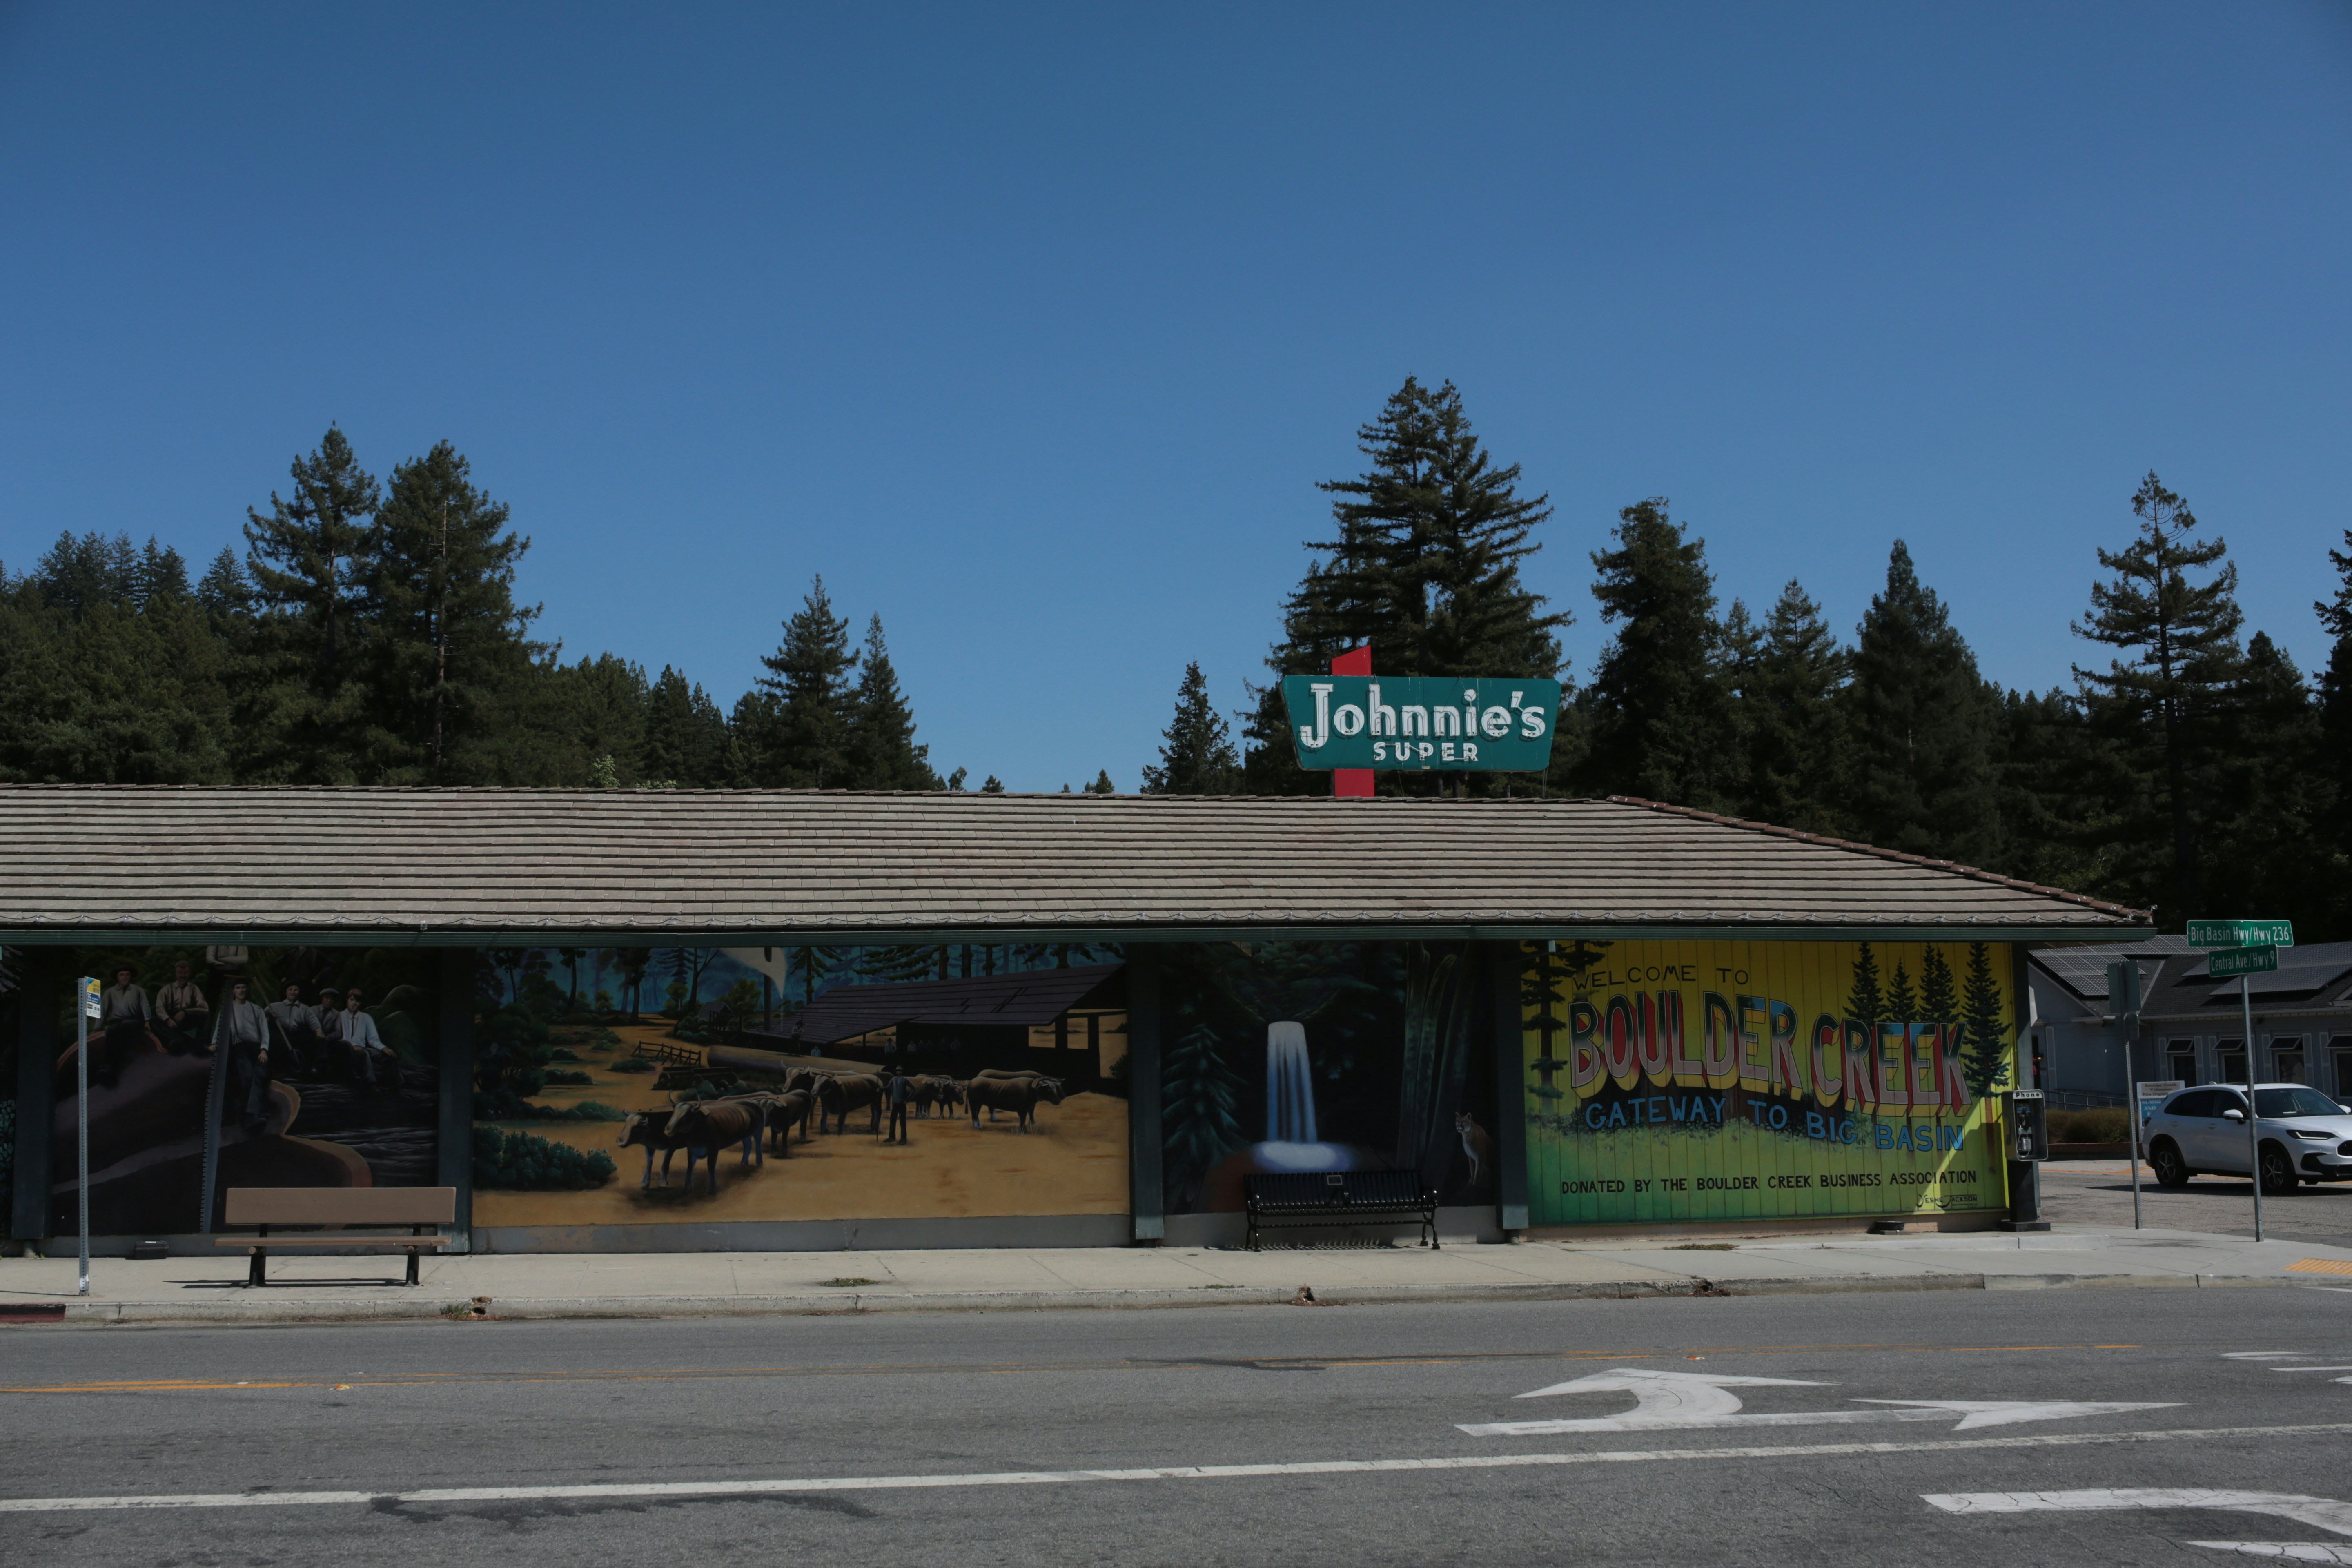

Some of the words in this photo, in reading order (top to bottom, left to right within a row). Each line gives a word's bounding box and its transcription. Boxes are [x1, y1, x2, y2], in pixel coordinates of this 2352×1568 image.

[1300, 683, 1546, 748] Johnnie's
[1373, 742, 1479, 762] SUPER
[2191, 927, 2204, 945] Big
[2207, 927, 2231, 941] Basin
[2233, 927, 2270, 944] Hwy/Hwy
[2272, 926, 2289, 941] 236
[2211, 955, 2234, 971] Central
[2270, 951, 2274, 965] 9
[1573, 965, 1696, 991] WELCOME
[1716, 968, 1749, 985] TO
[1568, 990, 1802, 1098] BOULDER
[1811, 1013, 1972, 1117] CREEK
[1585, 1096, 1727, 1129] GATEWAY
[1747, 1099, 1788, 1129] TO
[1806, 1111, 1858, 1145] BIG
[1875, 1124, 1964, 1152] BASIN
[1562, 1180, 1625, 1194] DONATED
[1635, 1179, 1652, 1192] BY
[1661, 1178, 1688, 1191] THE
[1697, 1176, 1759, 1190] BOULDER
[1768, 1175, 1812, 1188] CREEK
[1820, 1173, 1881, 1187] BUSINESS
[1890, 1170, 1976, 1185] ASSOCIATION
[1916, 1194, 1944, 1208] YESHE
[1935, 1194, 1977, 1208] JACKSON
